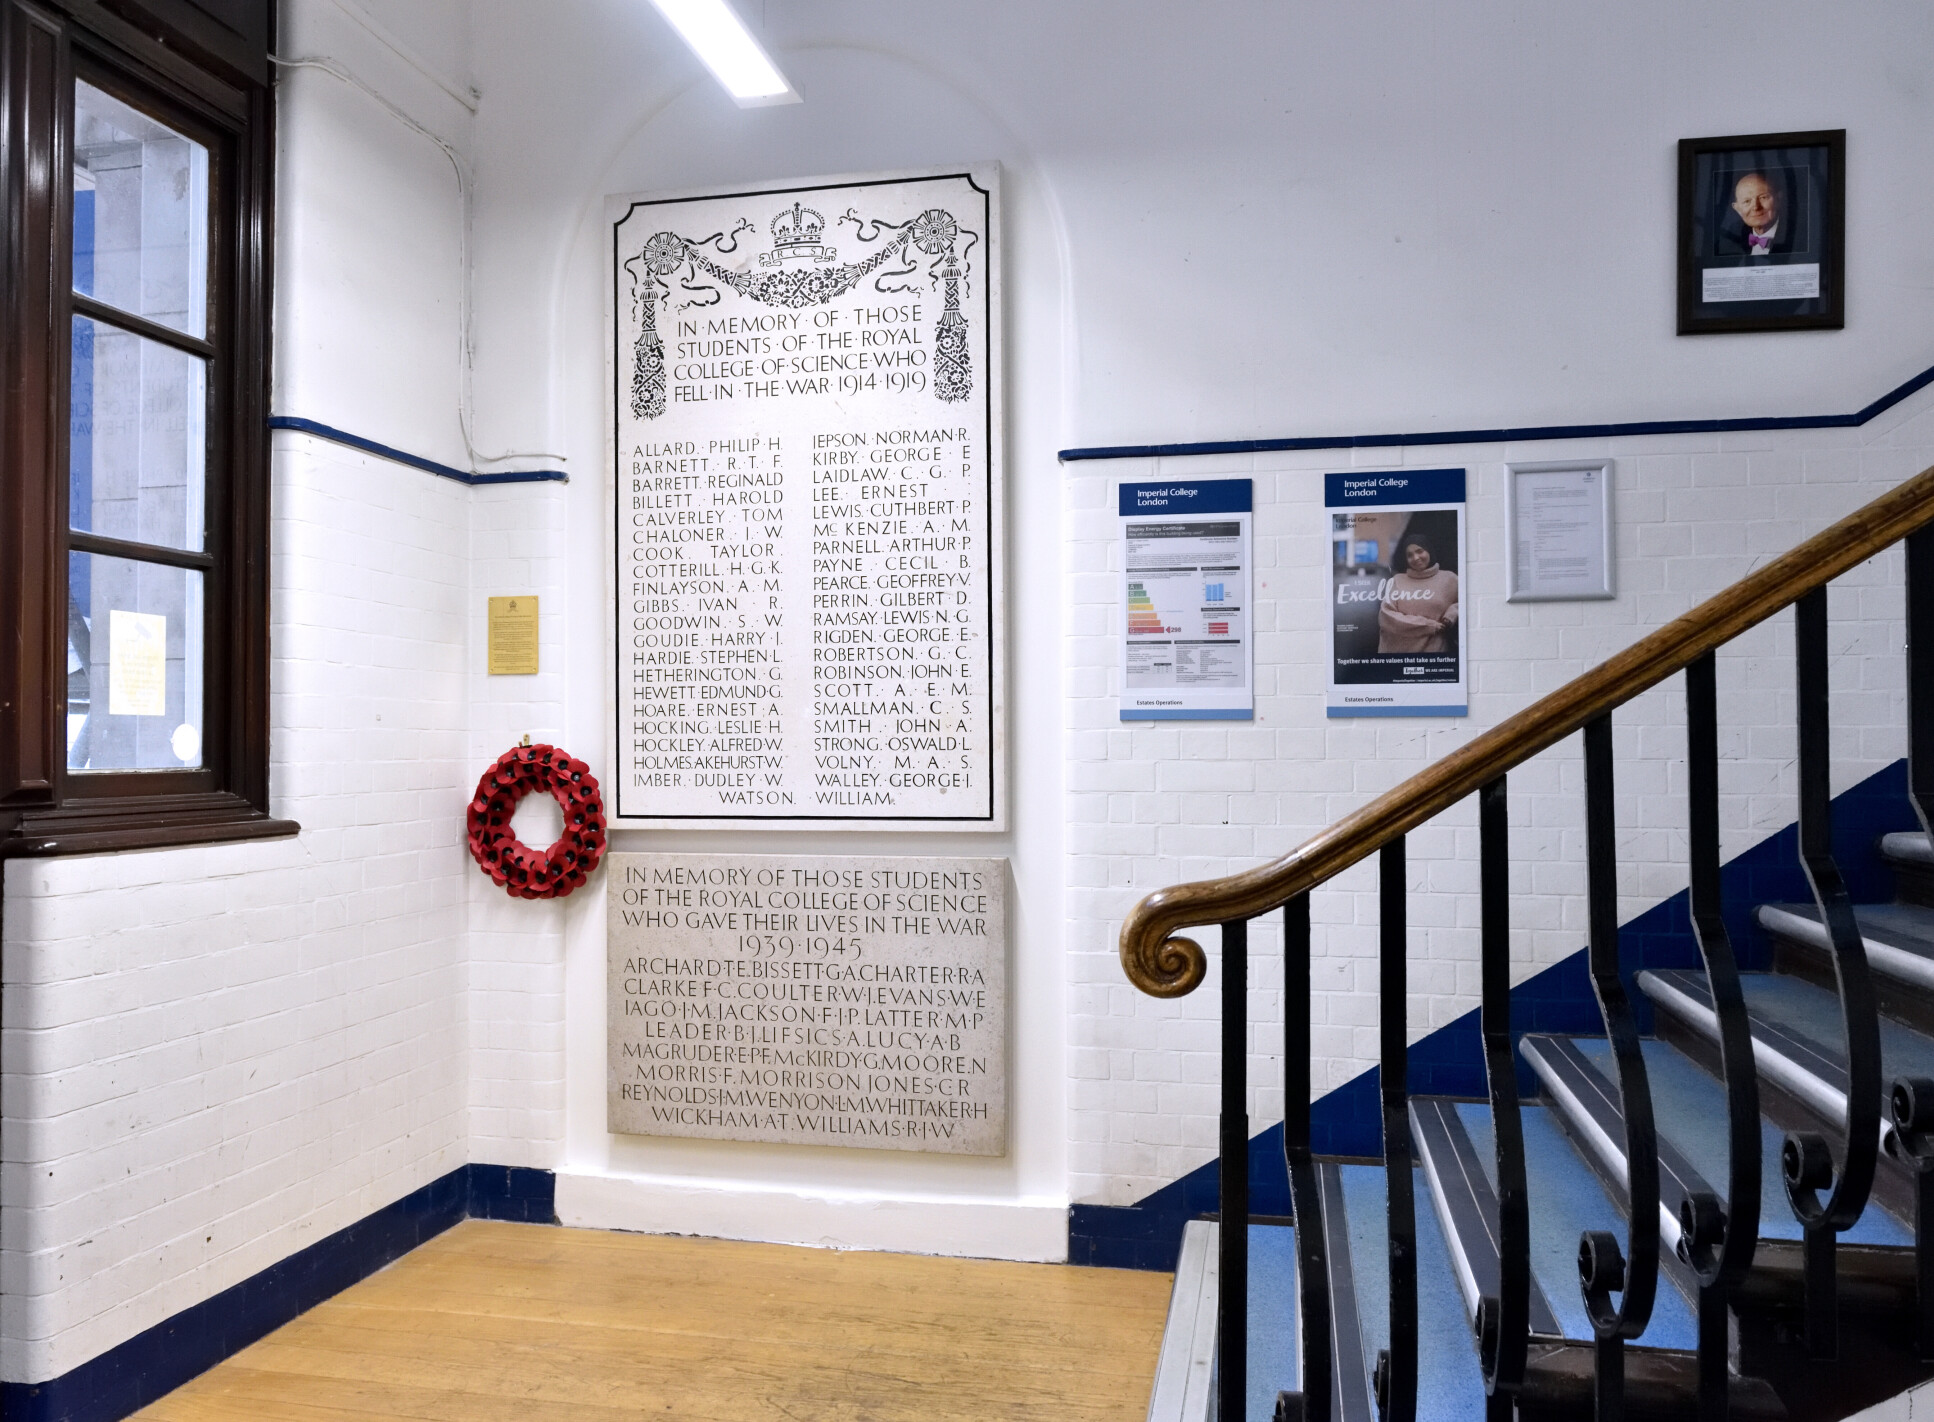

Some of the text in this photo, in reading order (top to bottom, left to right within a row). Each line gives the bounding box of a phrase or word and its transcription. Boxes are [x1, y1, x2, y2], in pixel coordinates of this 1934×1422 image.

[678, 304, 922, 338] IN MEMORY OF THOSE
[677, 327, 923, 360] STUDENTS OF THE ROYAL
[673, 349, 927, 381] COLLEGE OF SCIENCE WHO
[675, 370, 927, 402] FELL IN THE WAR 1914 1919
[876, 427, 953, 446] NORMAN
[709, 437, 760, 454] PHILIP
[869, 446, 942, 464] GEORGE
[708, 471, 784, 489] REGINALD
[1344, 478, 1408, 489] Imperial College
[632, 489, 784, 510] BILLETT HAROLD
[861, 483, 929, 500] ERNEST
[1137, 488, 1198, 497] Imperial College
[1344, 488, 1376, 497] London
[870, 500, 955, 518] CUTHBERT
[1137, 498, 1168, 506] London
[741, 507, 783, 522] TOM
[709, 542, 774, 559] TAYLOR
[886, 536, 956, 553] ARTHUR
[813, 555, 939, 573] PAYNE CECIL
[876, 572, 959, 589] GEOFFREY
[879, 590, 945, 607] GILBERT
[1337, 578, 1435, 604] Excellence
[698, 597, 737, 612] IVAN
[883, 609, 930, 625] LEWIS
[711, 631, 766, 647] HARRY
[700, 649, 768, 665] STEPHEN
[911, 663, 952, 680] JOHN
[701, 684, 767, 700] EDMUND
[697, 702, 757, 717] ERNEST
[718, 719, 762, 735] LESLIE
[814, 718, 941, 735] SMITH JOHN
[709, 737, 763, 752] ALFRED
[887, 736, 957, 752] OSWALD
[693, 755, 764, 770] AKEHURST
[694, 773, 756, 788] DUDLEY
[888, 772, 961, 788] GEORGE
[626, 866, 982, 891] IN MEMORY OF THOSE STUDENTS
[622, 888, 987, 914] OF THE ROYAL COLLEGE OF SCIENCE
[621, 909, 987, 937] WHO GAVE THEIR LIVES IN THE WAR
